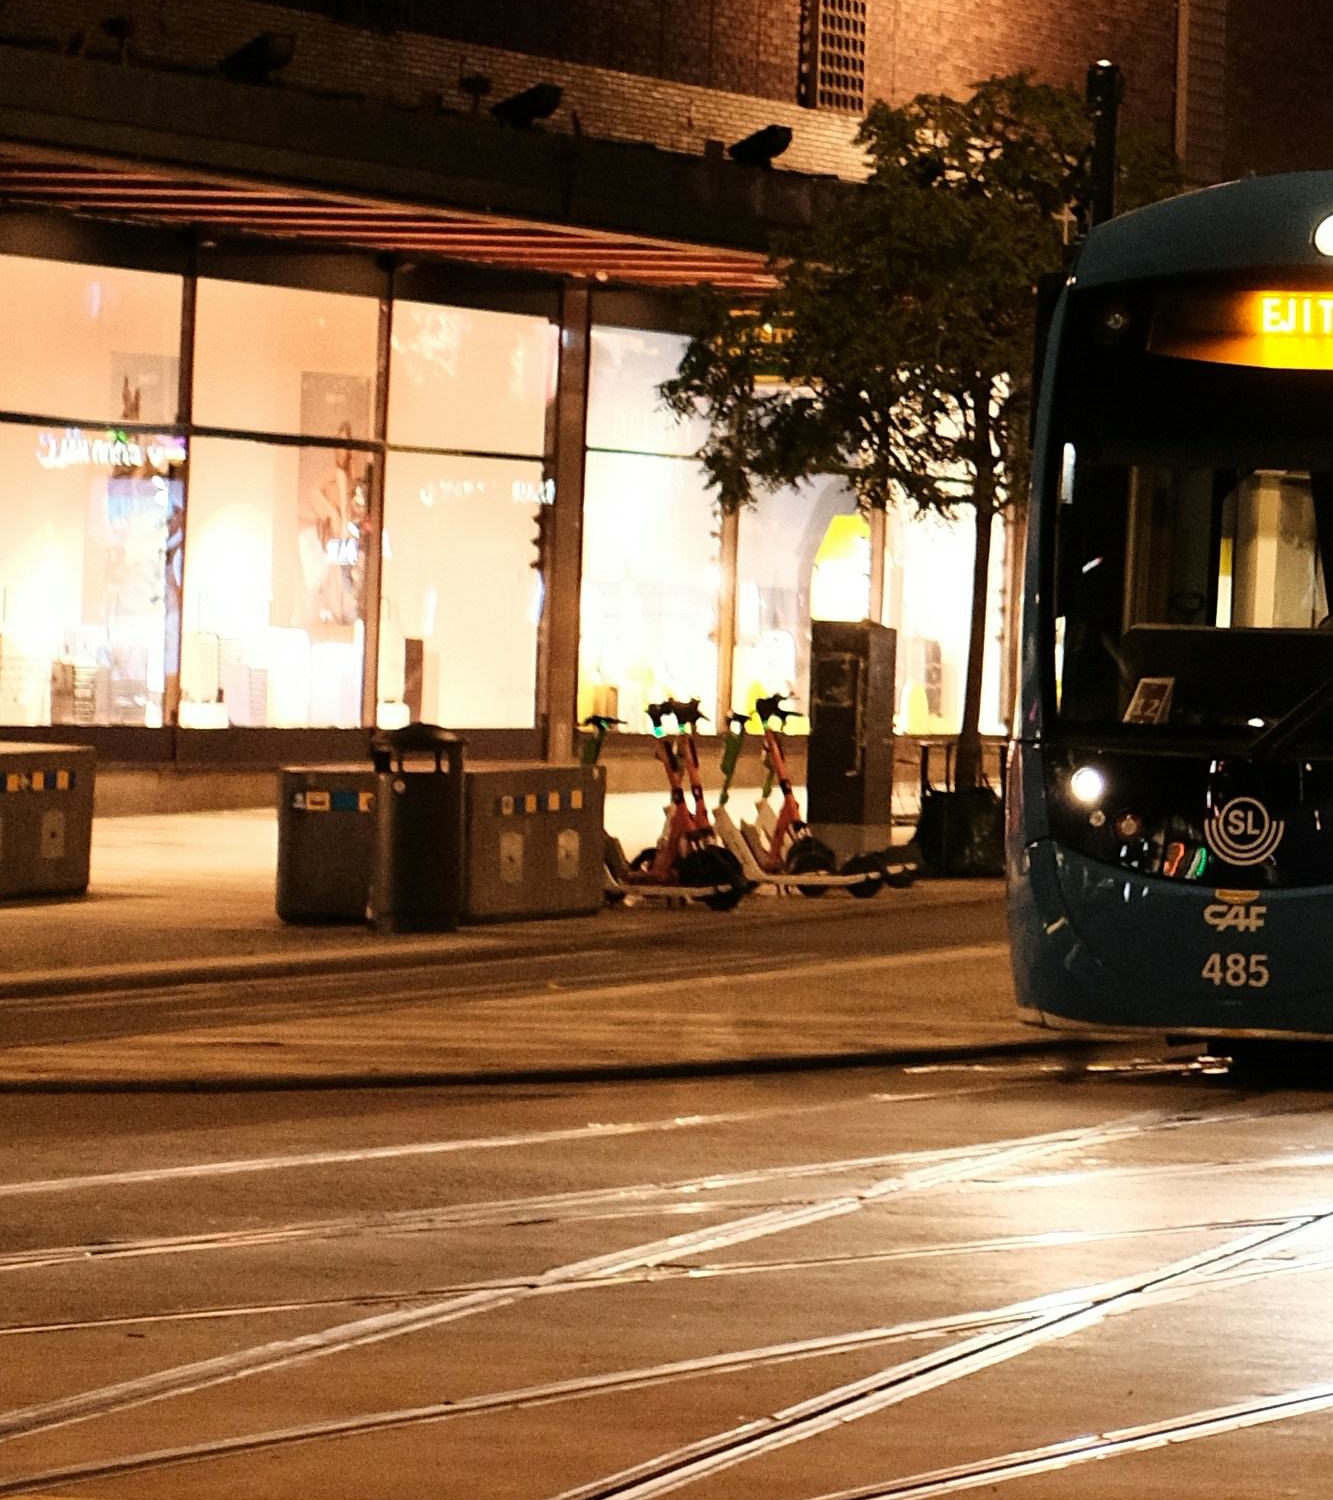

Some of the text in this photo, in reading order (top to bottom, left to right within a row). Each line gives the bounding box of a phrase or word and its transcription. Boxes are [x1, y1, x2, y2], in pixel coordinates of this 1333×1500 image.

[1262, 297, 1297, 333] EJ
[1303, 297, 1311, 333] I
[1227, 809, 1261, 836] SL
[1203, 903, 1267, 933] CAF
[1201, 951, 1270, 988] 485
